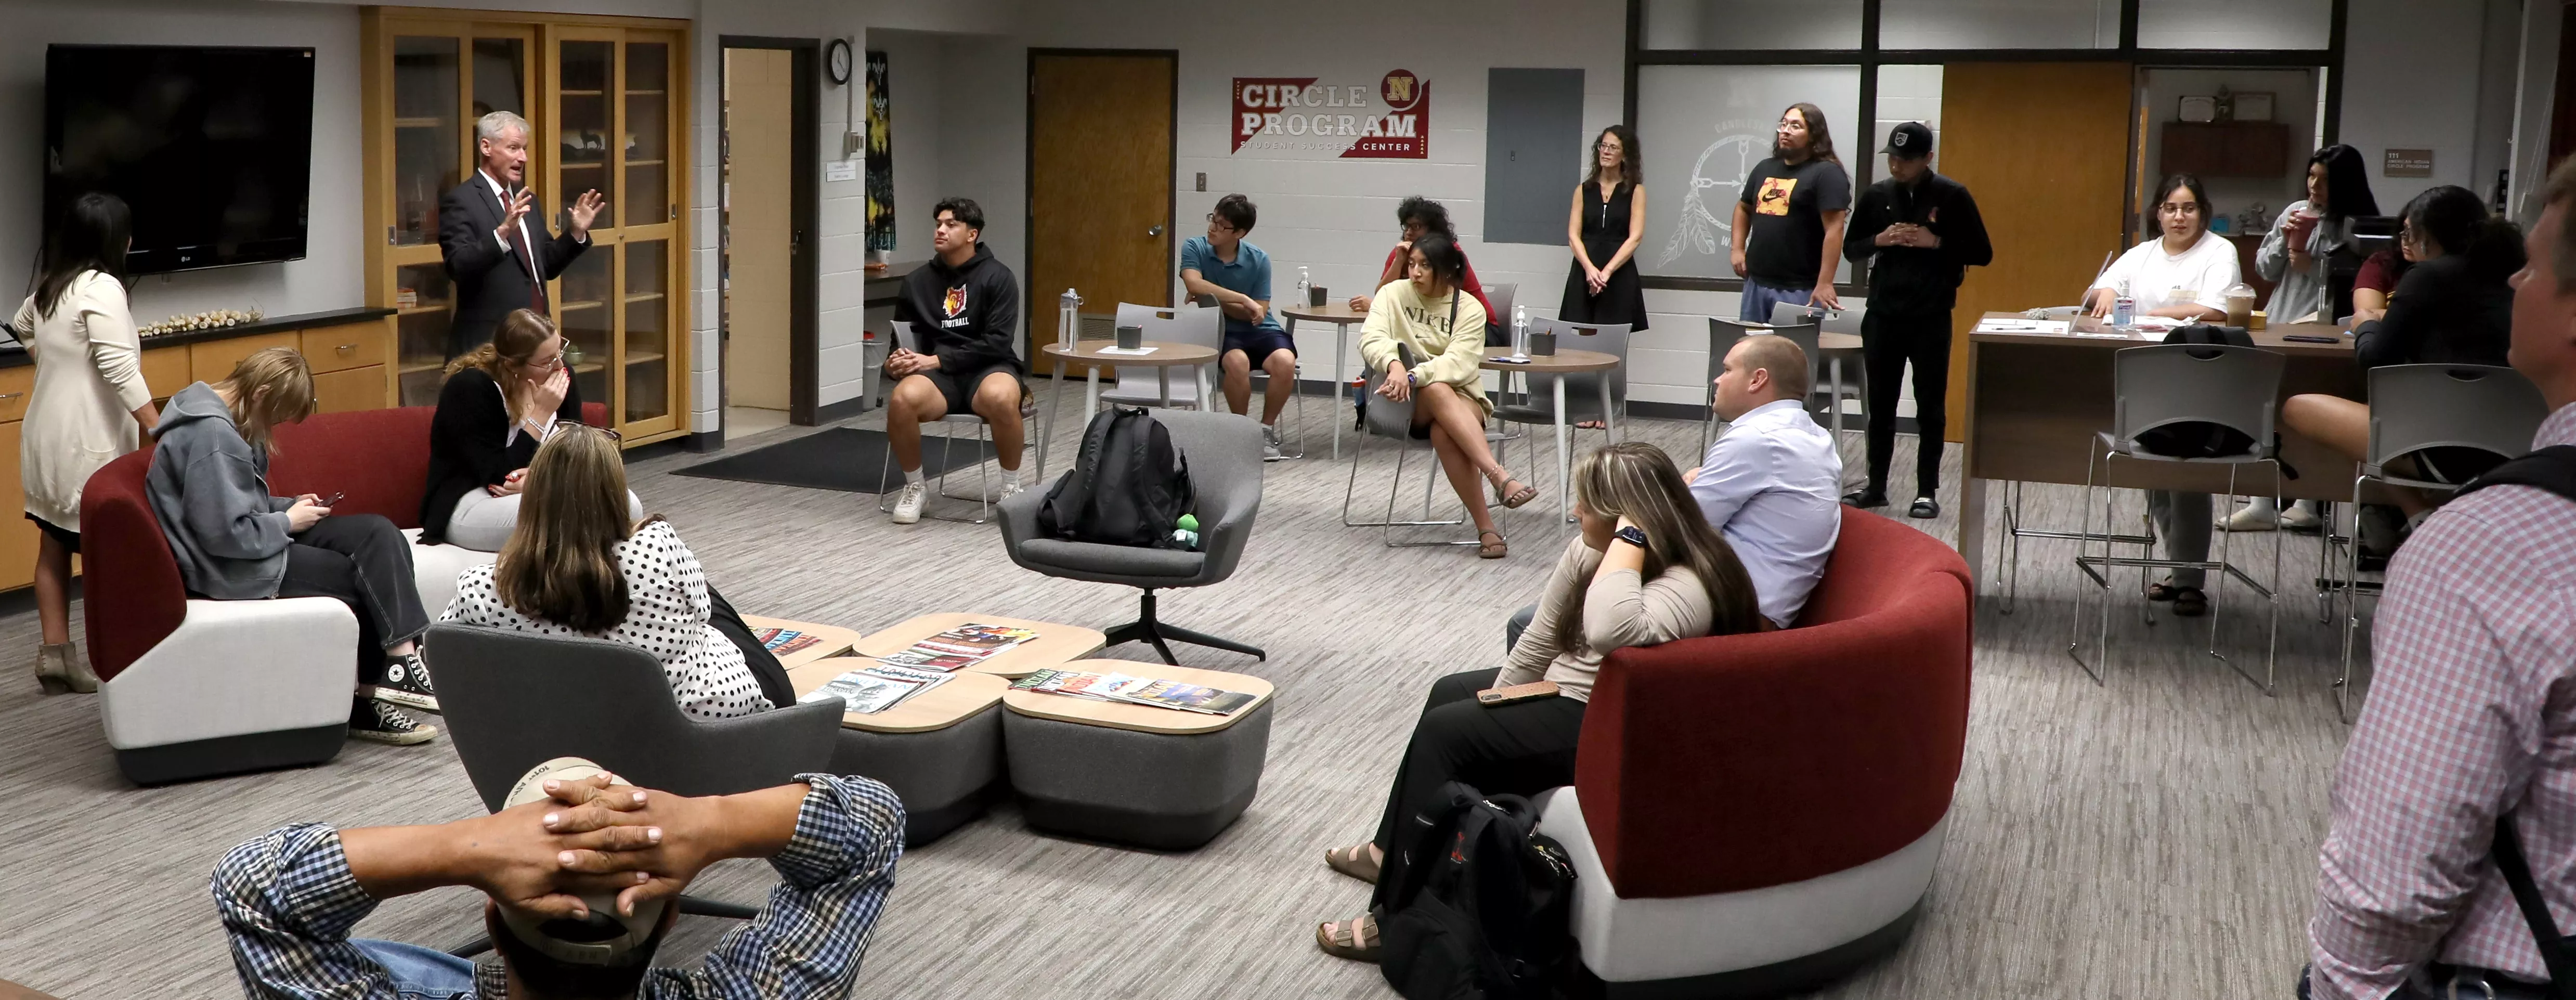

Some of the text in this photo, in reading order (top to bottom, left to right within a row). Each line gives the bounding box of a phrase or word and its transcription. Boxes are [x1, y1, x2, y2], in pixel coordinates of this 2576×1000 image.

[1242, 85, 1368, 108] CIRCLE
[1387, 77, 1413, 101] N
[1241, 113, 1417, 138] PROGRAM
[1240, 141, 1295, 150] STUDENT
[1302, 142, 1356, 150] SUCCESS
[941, 317, 969, 328] FOOTBALL
[1404, 307, 1451, 333] NIKE
[1014, 670, 1057, 689] INDIAN
